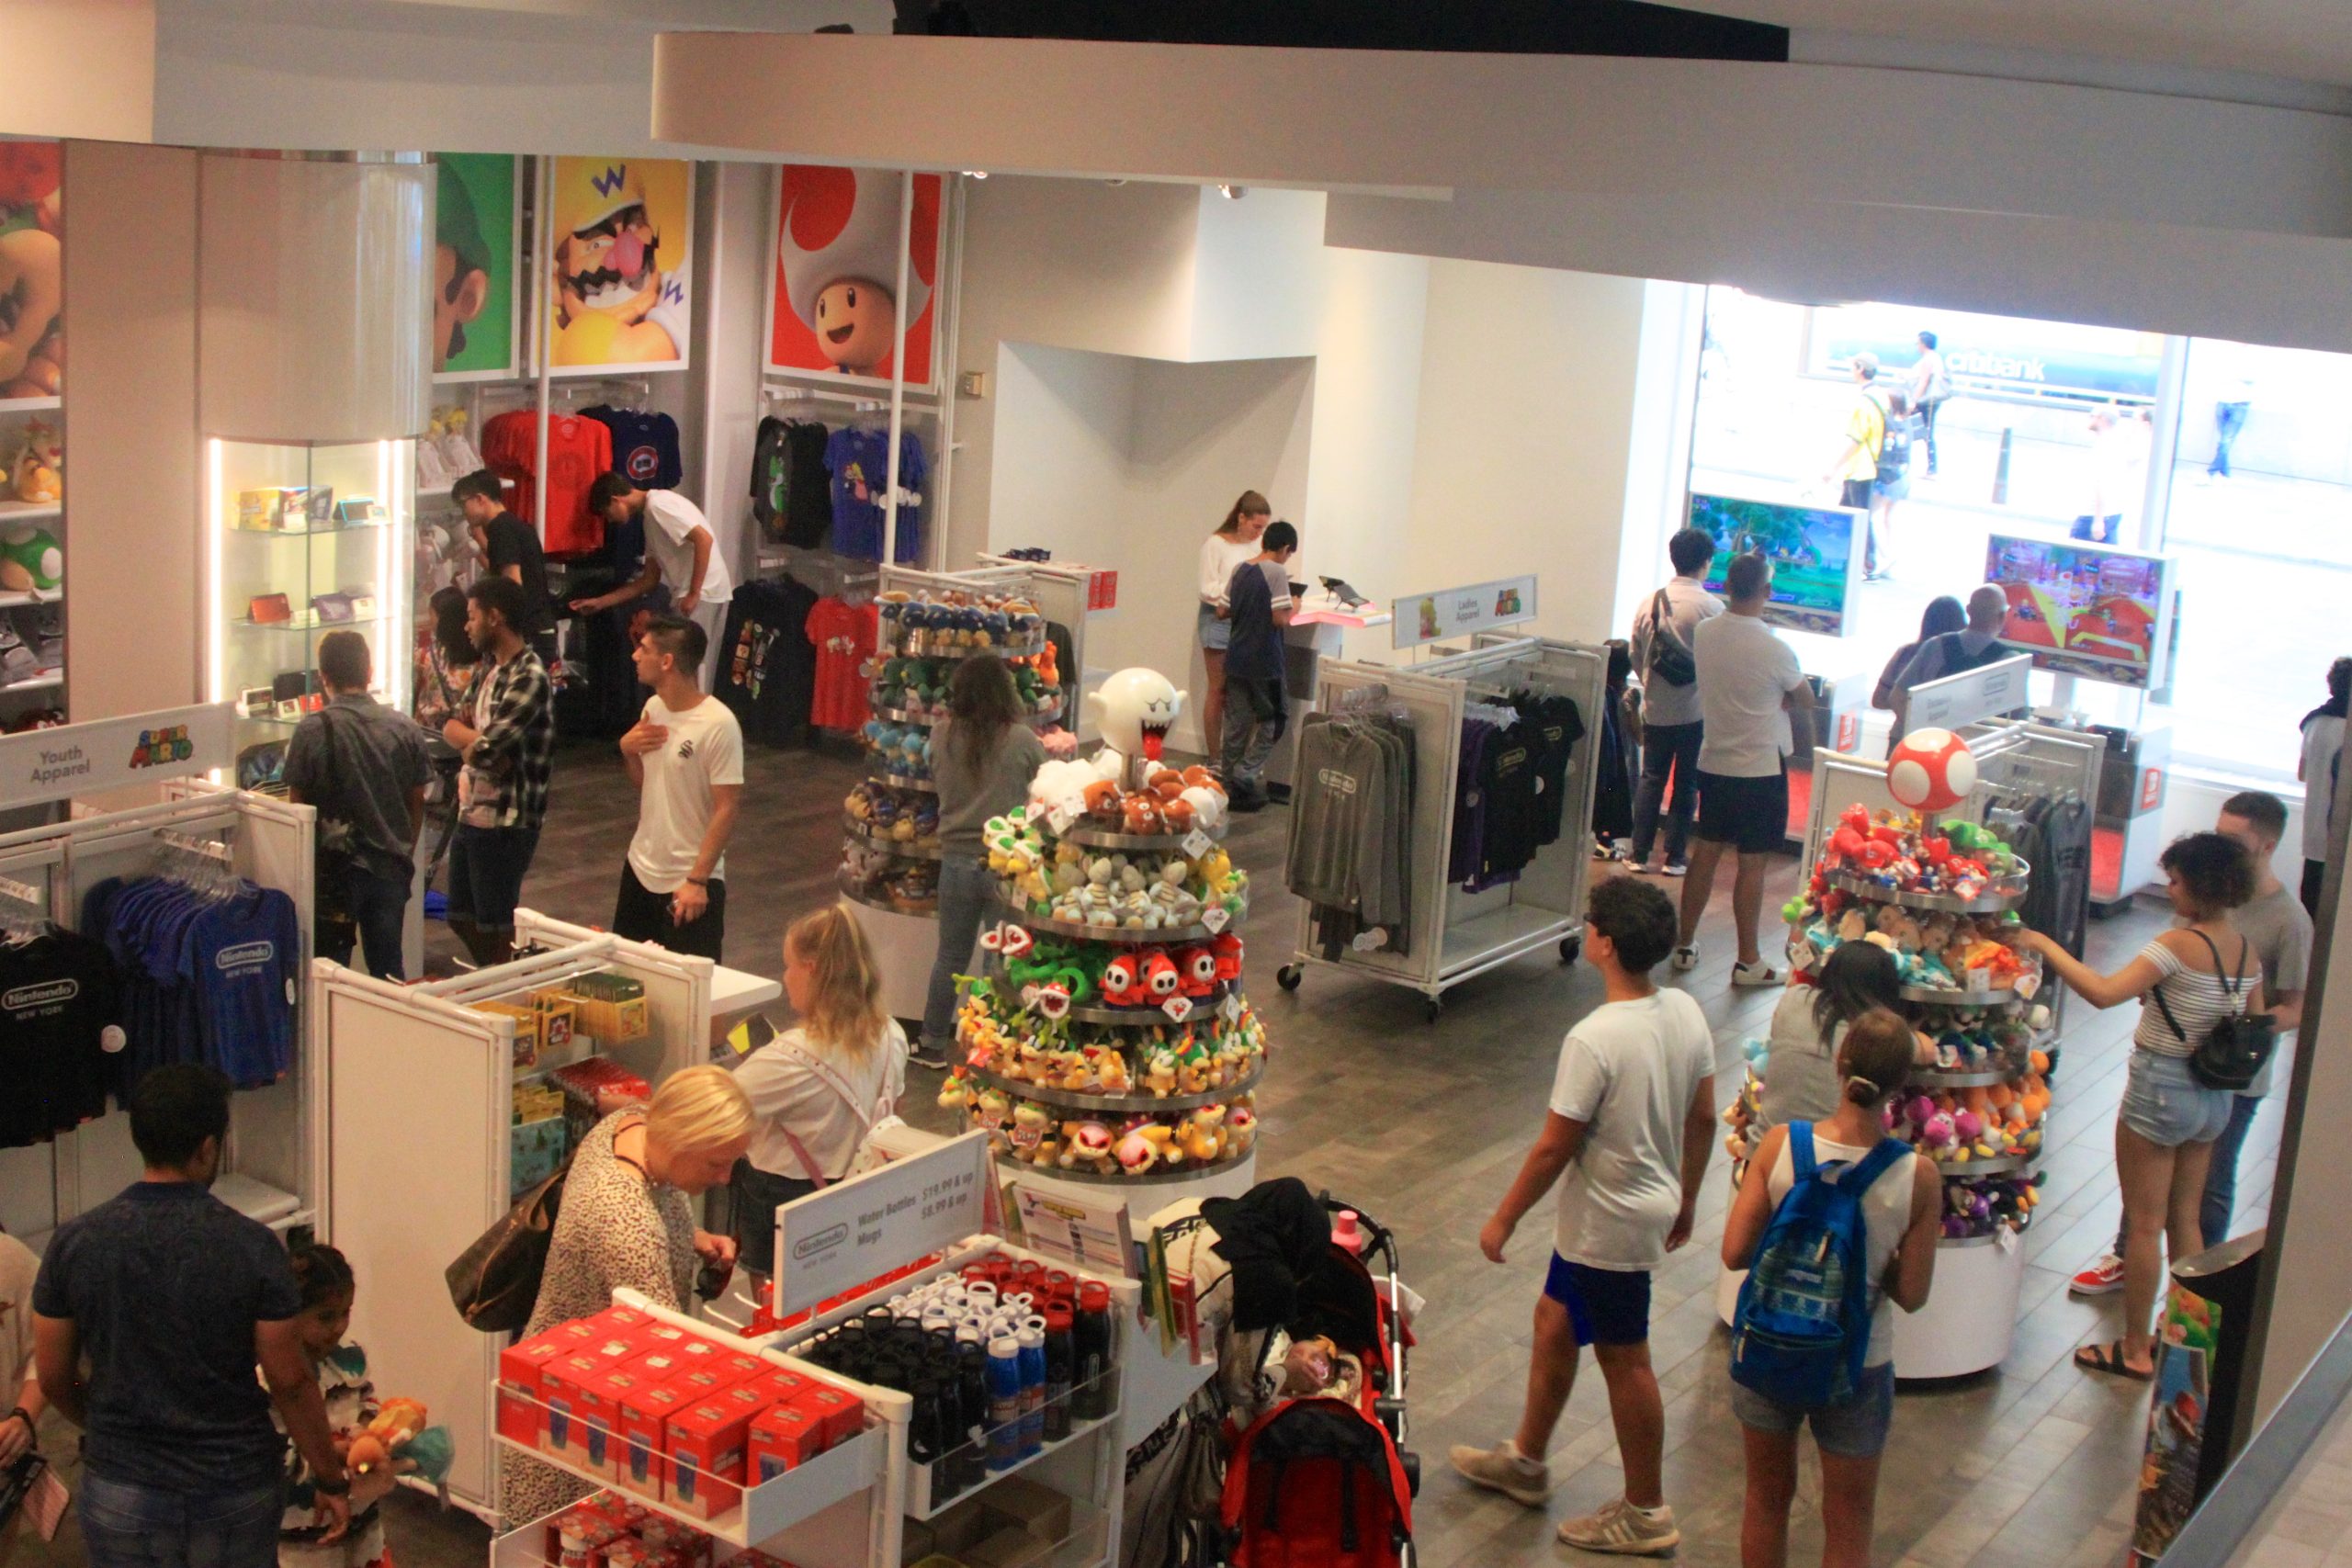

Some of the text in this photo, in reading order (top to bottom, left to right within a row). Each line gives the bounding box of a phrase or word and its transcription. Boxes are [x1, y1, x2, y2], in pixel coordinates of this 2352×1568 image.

[592, 164, 626, 198] W
[1456, 608, 1480, 624] Apparel
[40, 746, 83, 765] Youth
[30, 760, 90, 784] Apparel
[220, 946, 269, 964] Nintendo
[8, 985, 72, 1006] Nintendo
[858, 1209, 884, 1226] Water
[886, 1196, 917, 1216] Bottles
[922, 1178, 953, 1201] $19.99
[963, 1172, 973, 1185] up
[857, 1228, 882, 1246] Mugs
[921, 1199, 946, 1220] $8.99
[956, 1193, 967, 1207] up
[797, 1230, 843, 1255] Nintendo
